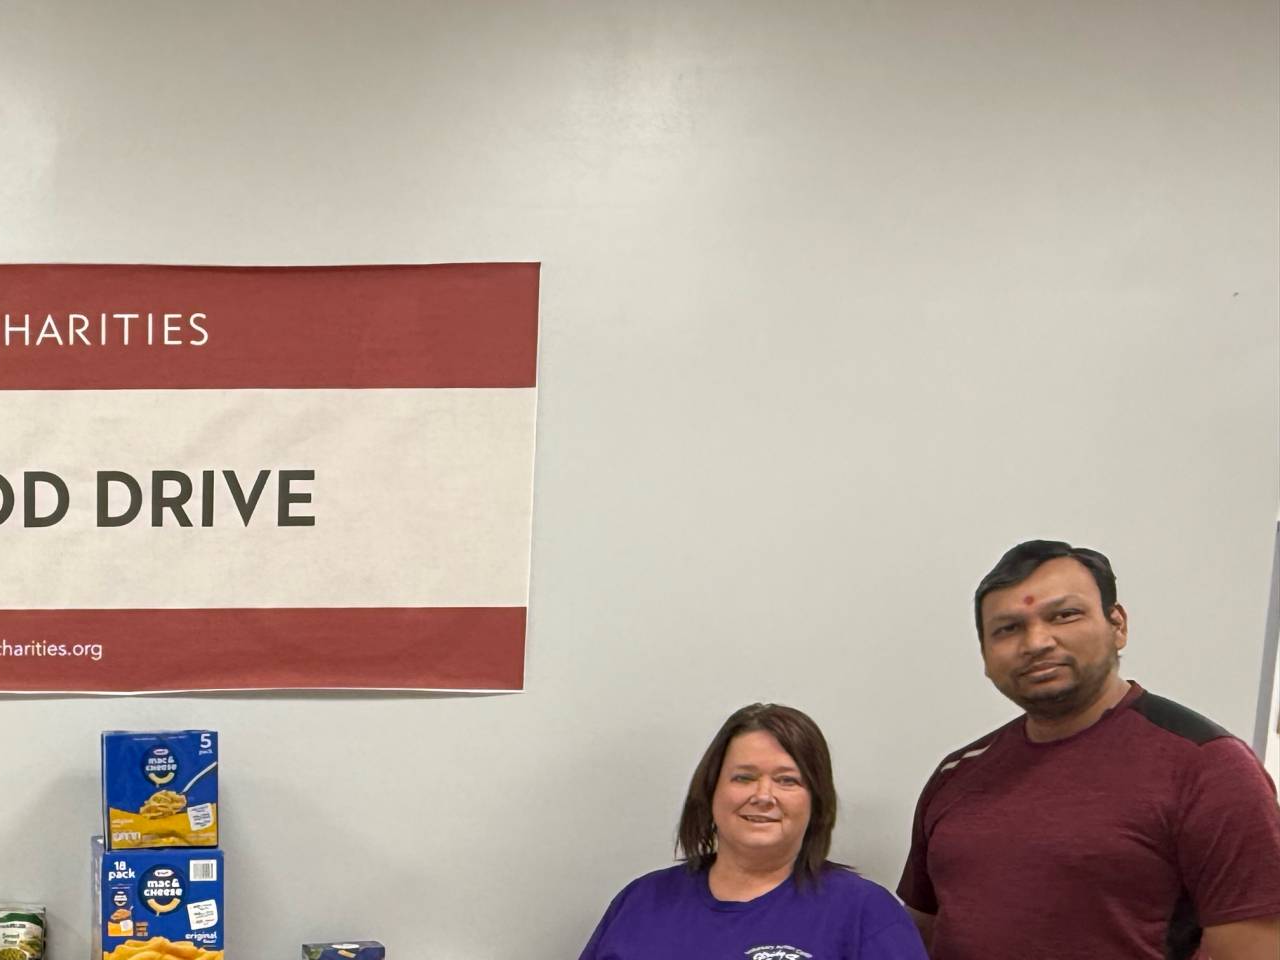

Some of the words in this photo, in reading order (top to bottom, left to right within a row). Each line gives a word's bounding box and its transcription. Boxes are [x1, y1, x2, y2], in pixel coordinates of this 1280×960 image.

[96, 468, 317, 528] DRIVE
[200, 733, 212, 748] 5
[113, 860, 127, 871] 18
[108, 868, 136, 881] pack
[147, 879, 170, 888] mac
